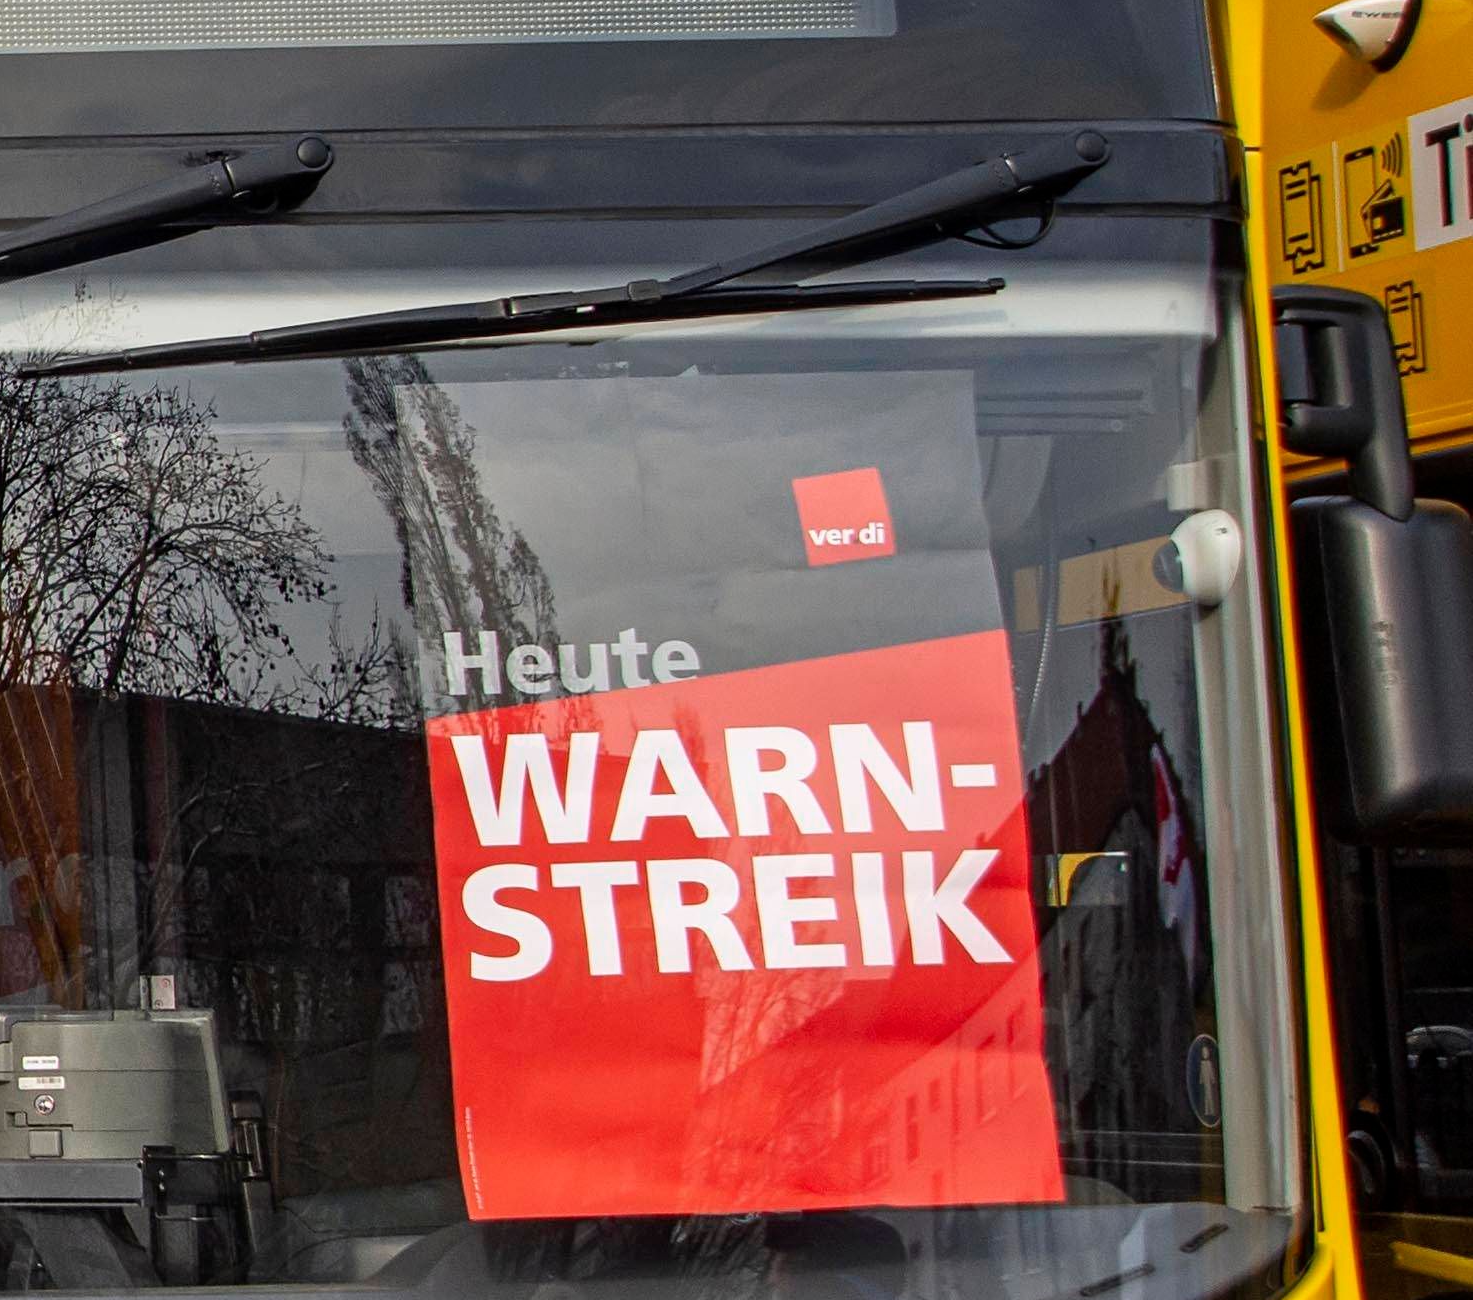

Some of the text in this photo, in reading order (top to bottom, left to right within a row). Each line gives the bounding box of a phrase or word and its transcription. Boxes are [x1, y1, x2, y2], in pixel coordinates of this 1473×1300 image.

[442, 627, 702, 696] Heute
[449, 720, 997, 848] WARN-
[460, 848, 1014, 983] STREIK
